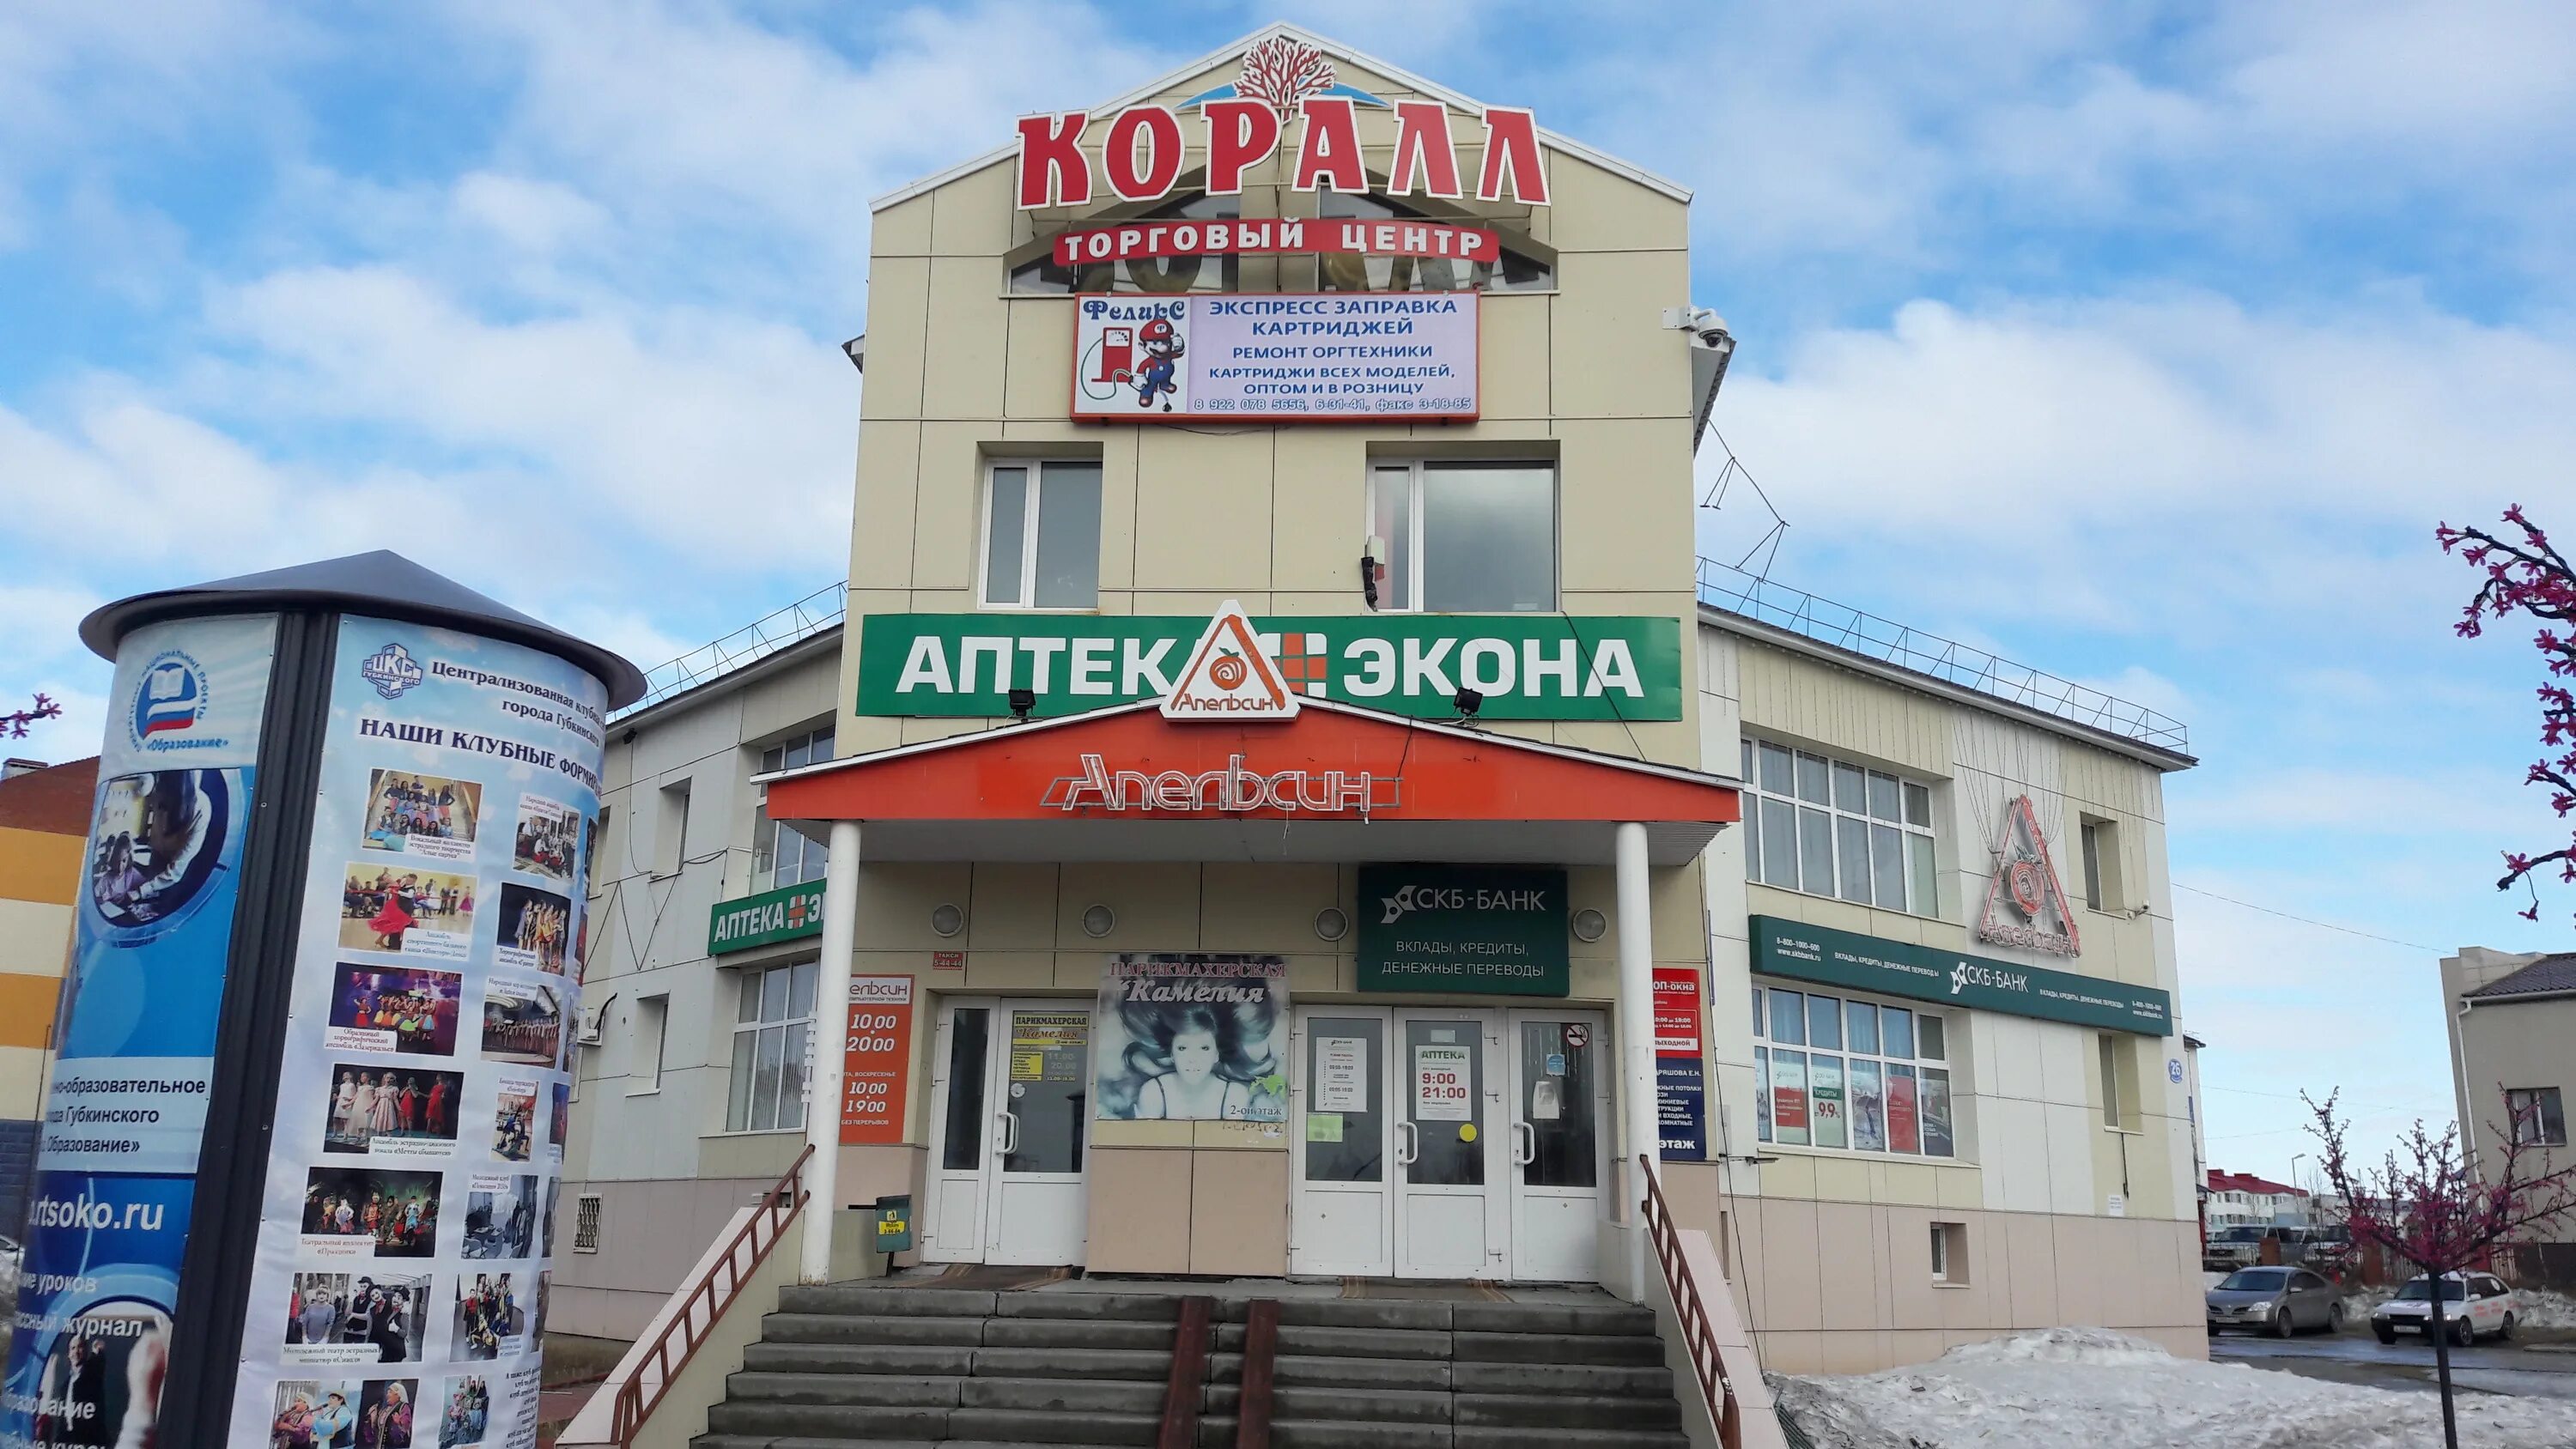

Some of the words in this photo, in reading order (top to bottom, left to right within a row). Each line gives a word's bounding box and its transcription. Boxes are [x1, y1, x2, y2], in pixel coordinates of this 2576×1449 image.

[1017, 96, 1551, 209] КОРАЛЛ
[1065, 218, 1303, 261] ТОРГОВЫЙ
[1341, 224, 1483, 257] ЦЕНТР
[1209, 300, 1327, 315] ЭКСПРЕСС
[1334, 300, 1458, 314] ЗАПРАВКА
[1252, 317, 1414, 337] КАРТРИДЖЕЙ
[1233, 346, 1308, 359] РЕМОНТ
[1312, 345, 1433, 358] ОРГТЕХНИКИ
[1209, 367, 1315, 379] КАРТРИДЖИ
[1320, 367, 1362, 378] ВСЕХ
[1366, 363, 1455, 379] МОДЕЛЕЙ,
[1243, 383, 1307, 394] ОПТОМ
[1311, 383, 1323, 394] И
[1327, 383, 1339, 394] В
[1343, 382, 1425, 396] РОЗНИЦУ
[1194, 399, 1204, 409] 8
[1209, 398, 1236, 409] 922
[1240, 398, 1267, 409] 078
[1271, 398, 1309, 411] 5656,
[1375, 397, 1414, 412] факс
[896, 635, 1204, 696] АПТЕК
[1342, 637, 1645, 698] ЭКОНА
[432, 660, 574, 709] Централизованная
[1178, 693, 1273, 711] Апельсин
[502, 700, 553, 723] города
[360, 718, 443, 745] НАШИ
[452, 731, 556, 769] КЛУБНЫЕ
[1061, 754, 1371, 812] Апельсин
[1417, 888, 1546, 911] СКБ-БАНК
[714, 902, 784, 943] АПТЕКА
[807, 891, 827, 924] Э
[1396, 941, 1455, 955] ВКЛАДЫ,
[1460, 943, 1528, 956] КРЕДИТЫ,
[1109, 961, 1287, 978] ПАРИКМАХЕРСКАЯ
[1382, 962, 1462, 974] ДЕНЕЖНЫЕ
[1467, 964, 1544, 978] ПЕРЕВОДЫ
[1834, 951, 1859, 963] ВКЛАДЫ,
[1858, 955, 1884, 968] КРЕДИТЫ,
[1884, 961, 1911, 973] ДЕНЕЖНЫЕ
[1911, 966, 1940, 977] ПЕРЕВОДЫ
[848, 980, 908, 996] ельсин
[1653, 980, 1696, 991] ОП-окна
[1967, 965, 2029, 993] СКБ-БАНК
[1016, 1016, 1087, 1025] ПАРИКМАХЕРСКАЯ
[1422, 1051, 1465, 1059] АПТЕКА
[2171, 1061, 2181, 1076] 26
[1422, 1073, 1455, 1084] 9:00
[1422, 1087, 1466, 1099] 21:00
[65, 1105, 161, 1127] Губкинского
[37, 1274, 98, 1294] уроков
[62, 1317, 143, 1339] журнал
